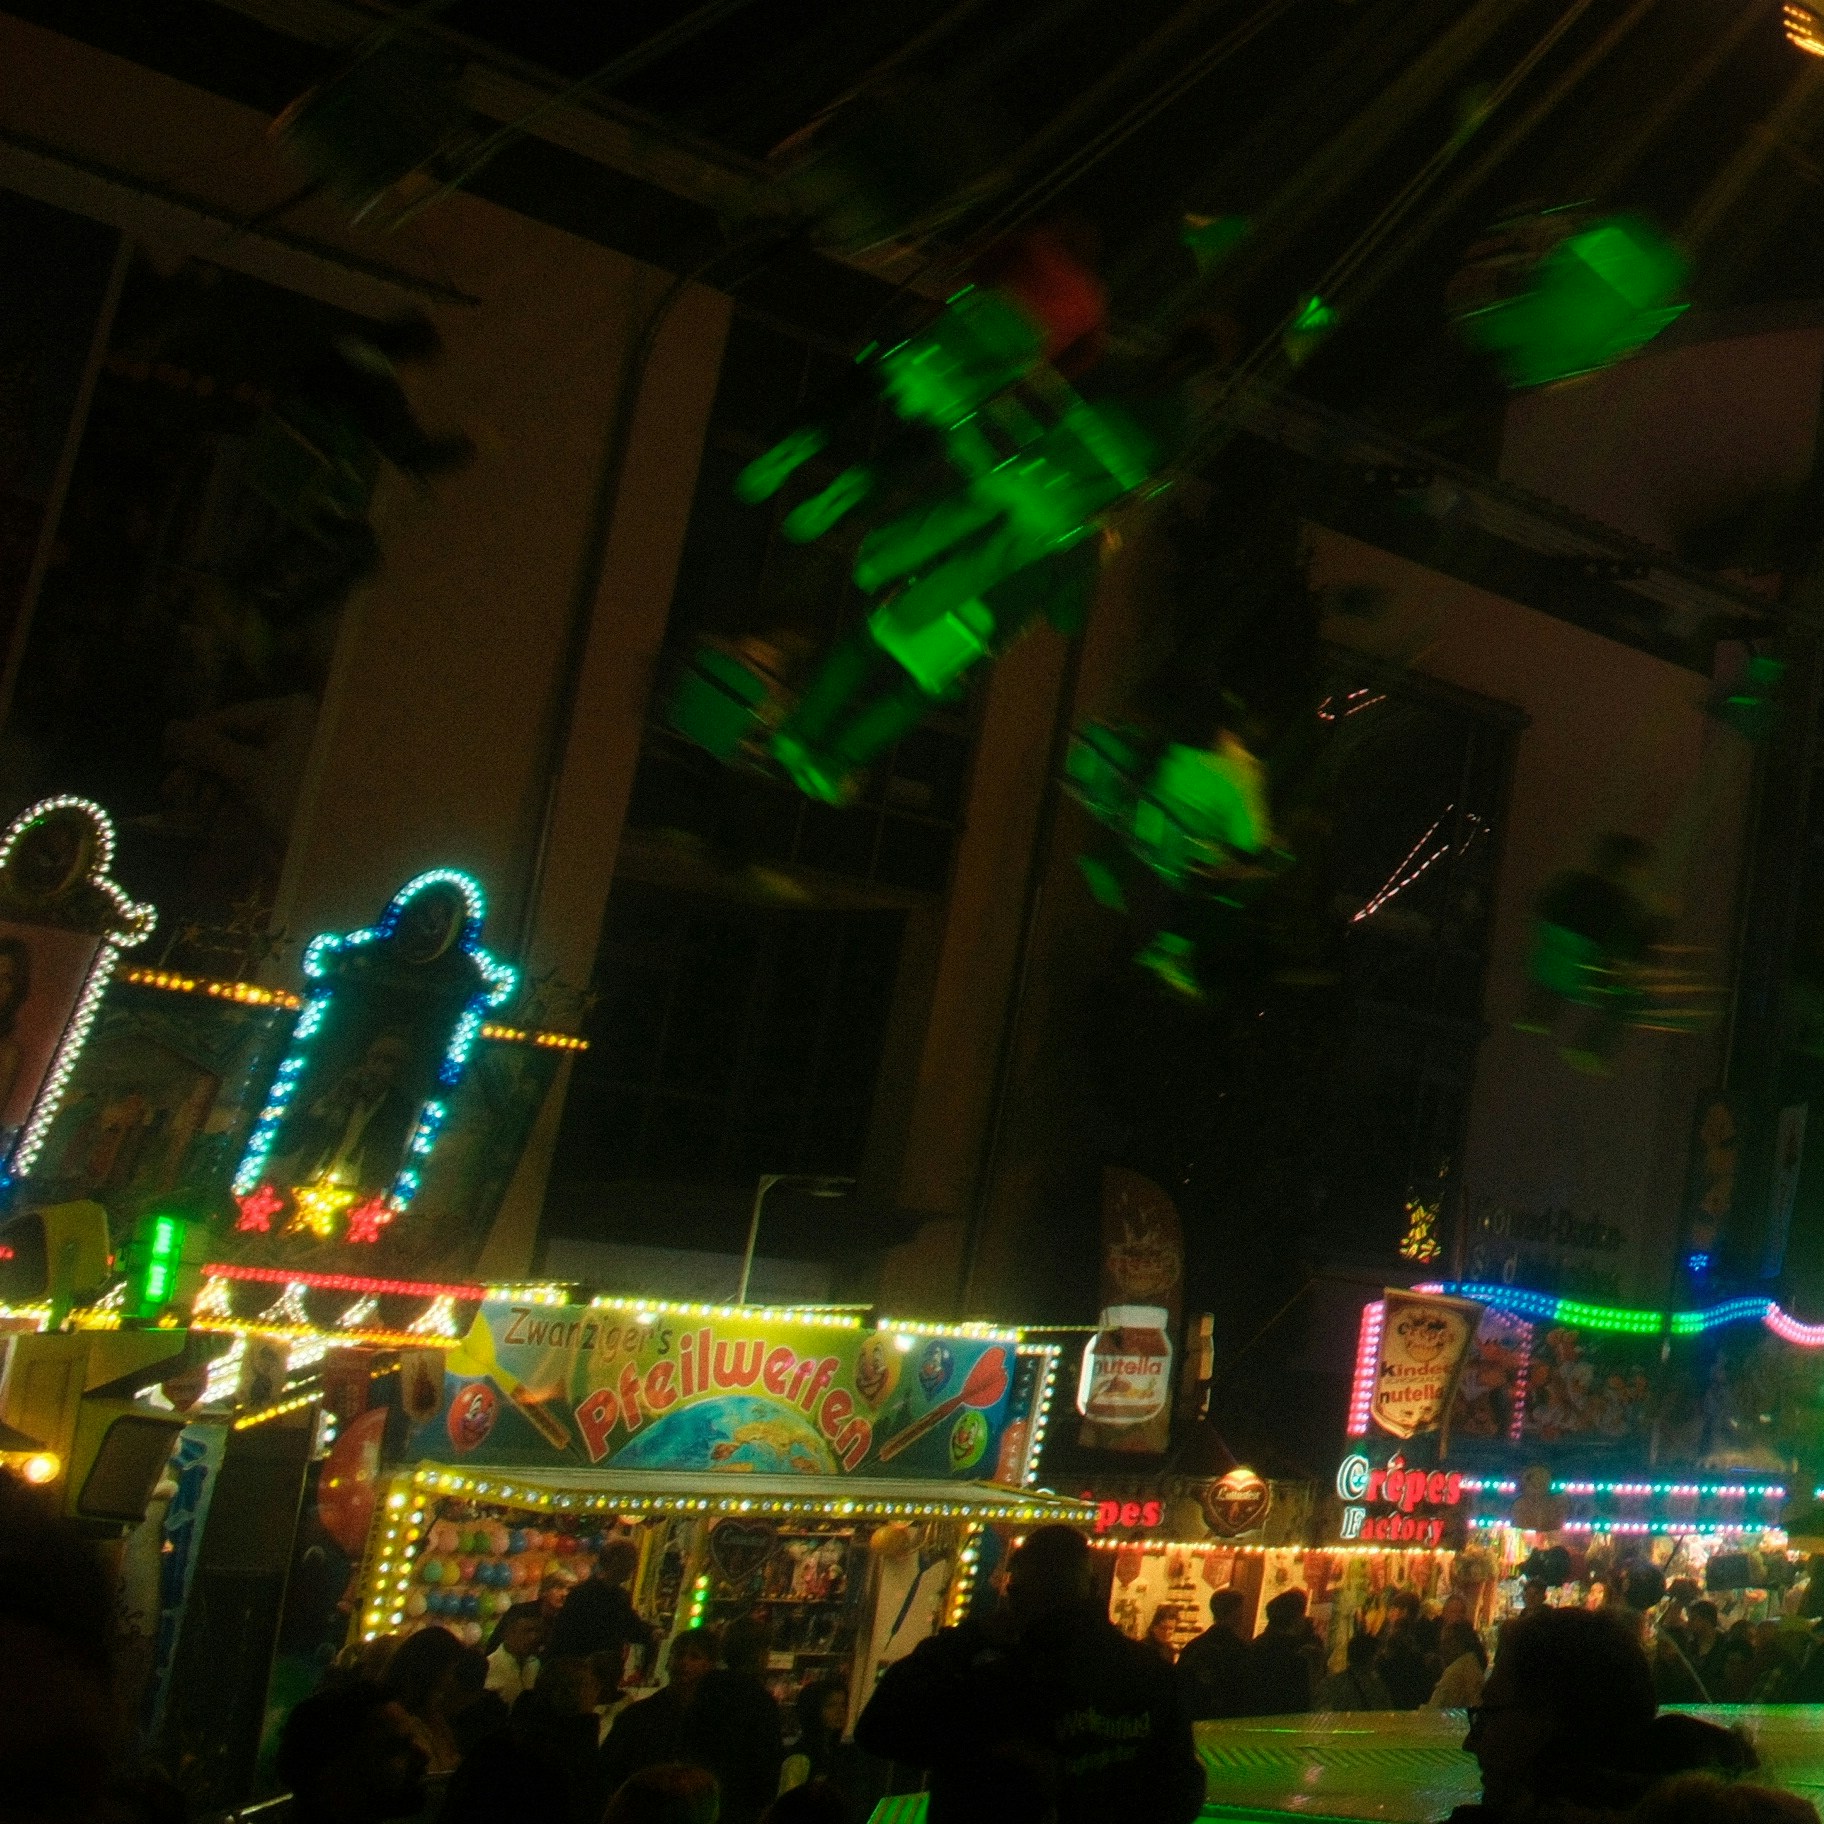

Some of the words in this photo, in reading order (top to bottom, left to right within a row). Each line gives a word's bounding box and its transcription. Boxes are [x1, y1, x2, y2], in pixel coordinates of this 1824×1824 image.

[504, 1307, 672, 1362] Zwanziger's
[575, 1328, 873, 1472] Pfeilwerfen
[1336, 1449, 1463, 1513] Crêpes
[1340, 1506, 1445, 1547] Factory
